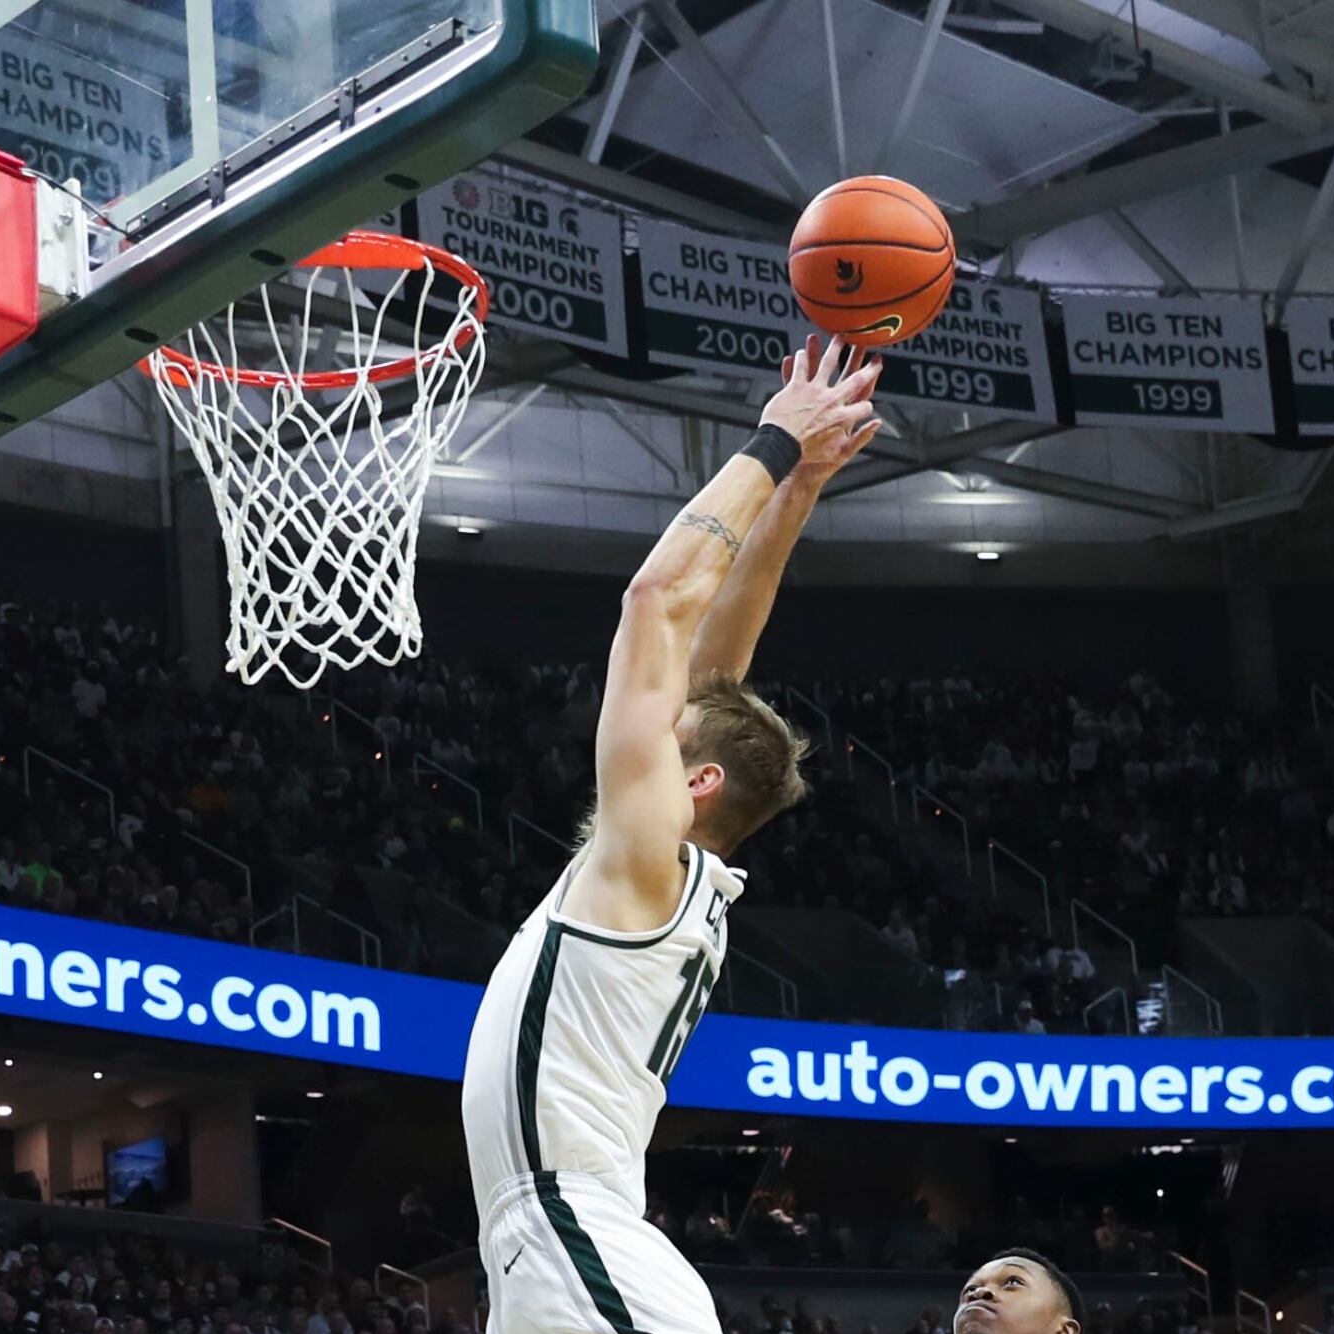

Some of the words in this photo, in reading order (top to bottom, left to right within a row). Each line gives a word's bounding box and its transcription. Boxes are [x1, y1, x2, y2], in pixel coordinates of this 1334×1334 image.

[0, 51, 54, 88] BIG
[63, 71, 123, 114] TEN
[20, 142, 121, 195] 2009
[441, 205, 602, 266] TOURNAMENT
[442, 231, 604, 294] CHAMPIONS
[679, 243, 728, 273] BIG
[696, 323, 786, 366] 2000
[1105, 311, 1157, 336] BIG
[1165, 313, 1223, 338] TEN
[1073, 340, 1262, 370] CHAMPIONS
[910, 363, 995, 403] 1999
[1132, 383, 1213, 413] 1999
